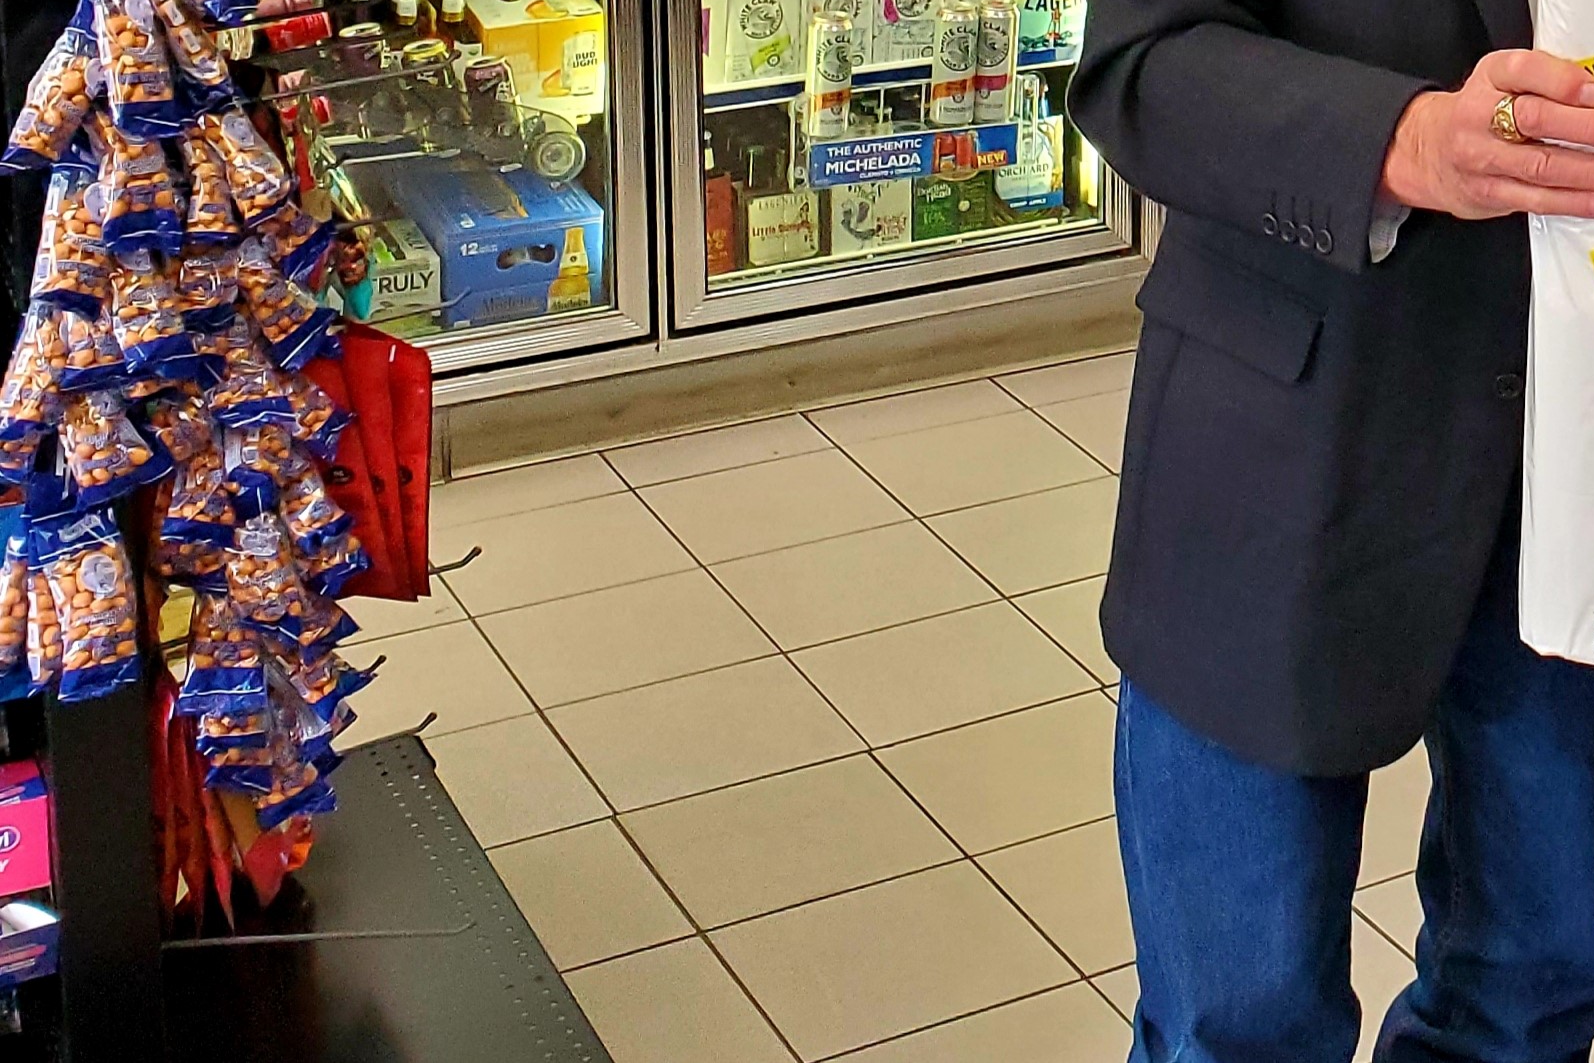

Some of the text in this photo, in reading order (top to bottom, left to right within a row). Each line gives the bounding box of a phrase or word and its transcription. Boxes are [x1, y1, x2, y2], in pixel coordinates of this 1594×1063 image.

[572, 57, 598, 68] LIGHT
[575, 50, 596, 61] BUD
[826, 138, 923, 158] THE AUTHENTIC
[825, 152, 1006, 175] MICHELADA NEW
[459, 242, 479, 257] 12
